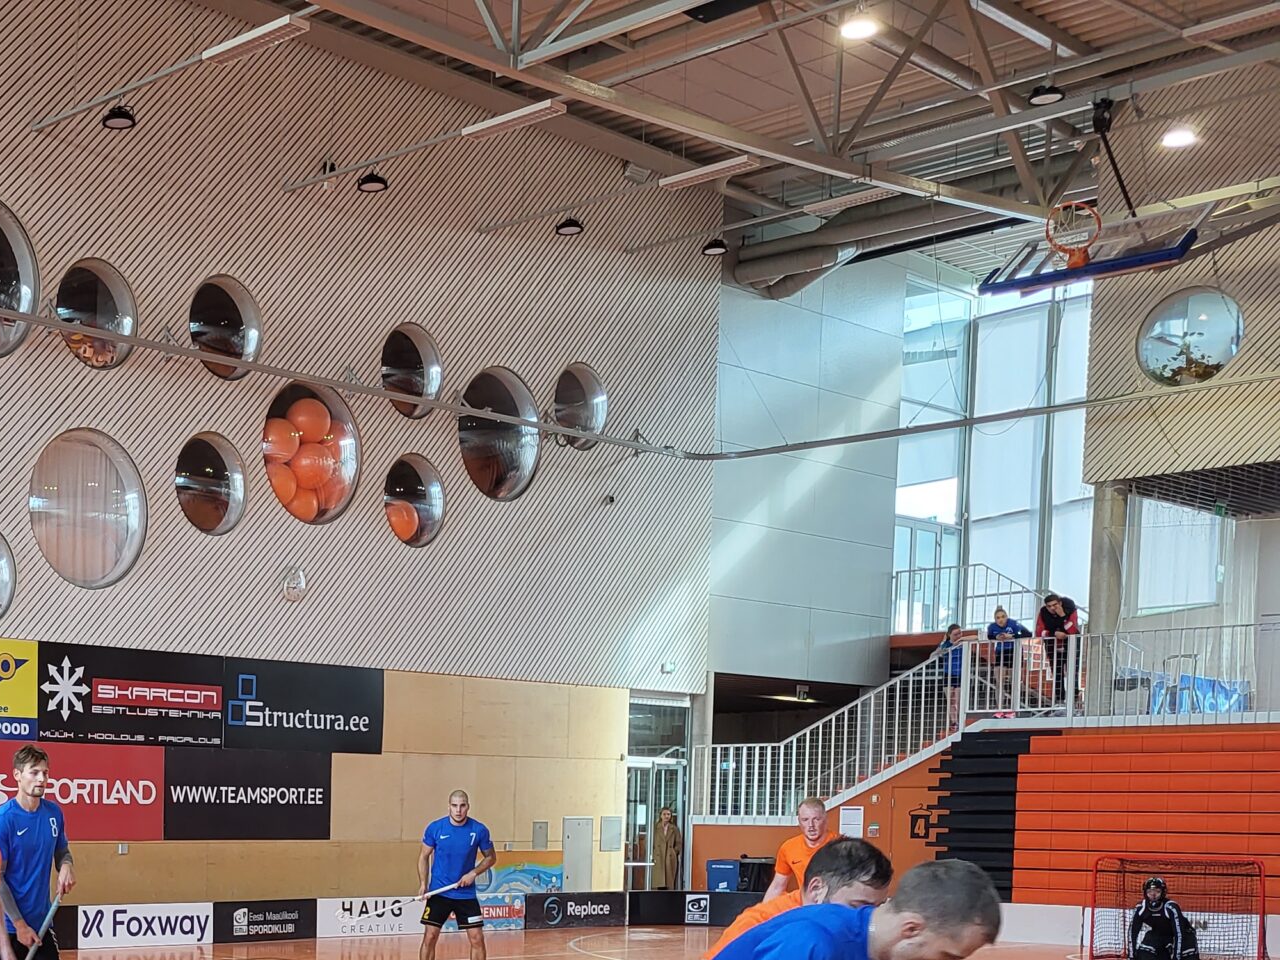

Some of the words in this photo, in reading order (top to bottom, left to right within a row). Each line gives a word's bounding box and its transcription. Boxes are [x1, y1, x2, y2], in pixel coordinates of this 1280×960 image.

[97, 685, 217, 705] SKARCON
[91, 705, 222, 720] ESITLUSTEHNIKA
[245, 700, 370, 732] Structura.ee
[88, 733, 145, 742] HOOLDUS
[170, 785, 324, 806] WWW.TEAMSPORT.EE
[913, 818, 926, 837] 4
[341, 899, 403, 919] HAUG
[481, 906, 509, 918] ENNI!
[567, 900, 611, 918] Replace
[112, 909, 210, 942] Foxway
[248, 923, 295, 935] SPORDIKLUBI
[341, 923, 404, 934] CREATIVE
